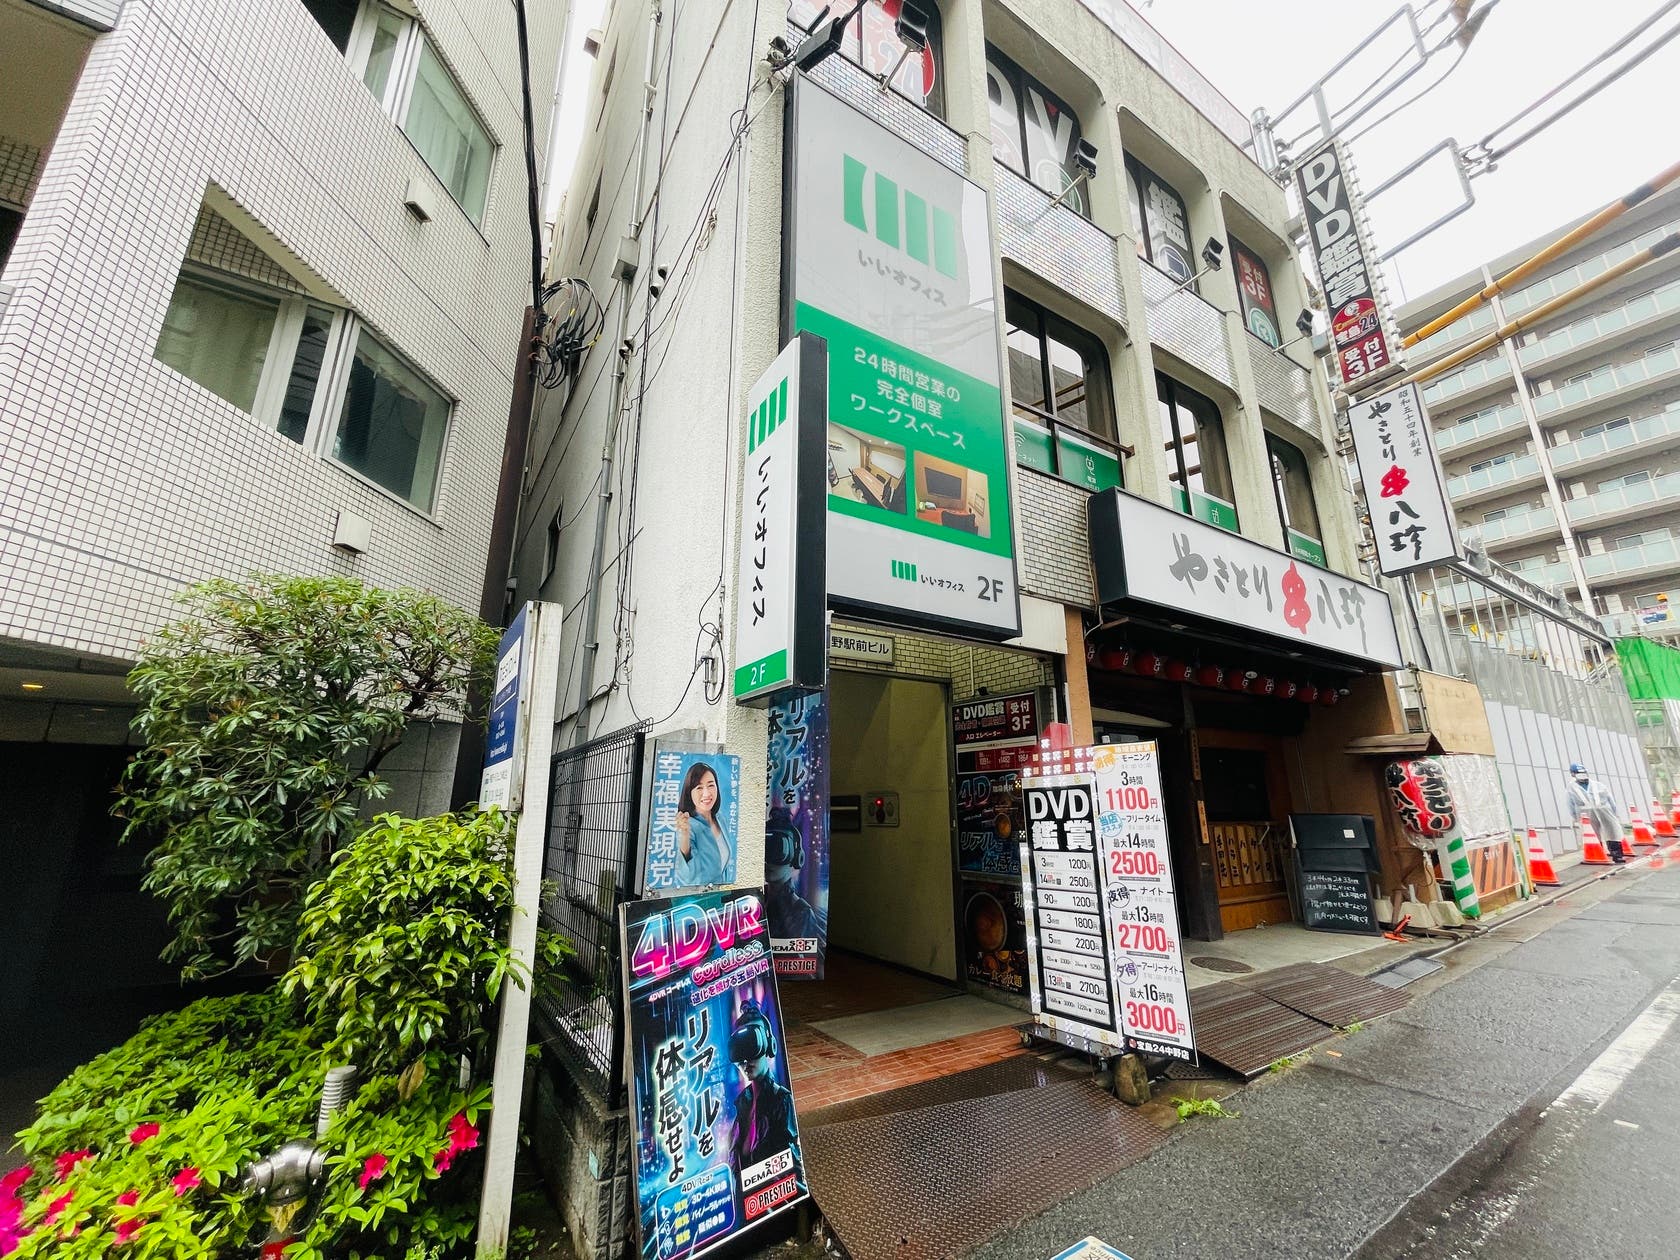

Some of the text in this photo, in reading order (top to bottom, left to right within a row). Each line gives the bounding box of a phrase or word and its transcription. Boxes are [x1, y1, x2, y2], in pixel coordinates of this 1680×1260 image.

[1302, 152, 1368, 309] DVD鑑賞
[857, 249, 947, 307] いいオフィス
[1344, 336, 1380, 363] 受付
[854, 347, 960, 402] 24時間営業の
[1347, 353, 1385, 379] 3F
[876, 379, 942, 419] 完全個室
[850, 394, 966, 450] ワークスペース
[753, 455, 771, 627] いいオフィス
[920, 574, 1004, 603] いいオフィス 2F
[831, 635, 889, 655] 野駅前ビル
[750, 662, 767, 686] 2F
[1010, 700, 1030, 714] 受付
[1011, 716, 1030, 731] 3F
[1122, 753, 1151, 762] モーニング
[1121, 771, 1143, 786] 3時間
[1028, 789, 1090, 820] DVD
[1106, 787, 1158, 810] 1100円
[650, 754, 682, 887] 幸福実現党
[1031, 819, 1094, 851] 鑑賞
[1114, 833, 1155, 848] 最大14時間
[1110, 851, 1166, 875] 2500円
[1122, 906, 1164, 923] 最大13時間
[632, 895, 764, 979] 4DVR
[789, 938, 817, 946] SOFT
[1118, 924, 1175, 952] 2700円
[692, 940, 764, 986] cordless
[778, 960, 816, 972] PRESTIGE
[1130, 983, 1174, 1004] 最大16時間
[1126, 1001, 1186, 1035] 3000円
[688, 1006, 721, 1161] リアルを
[655, 1040, 688, 1183] 体感せよ
[765, 1151, 790, 1168] SOFT
[743, 1161, 788, 1187] DEMAND
[759, 1179, 797, 1208] PRESTIGE
